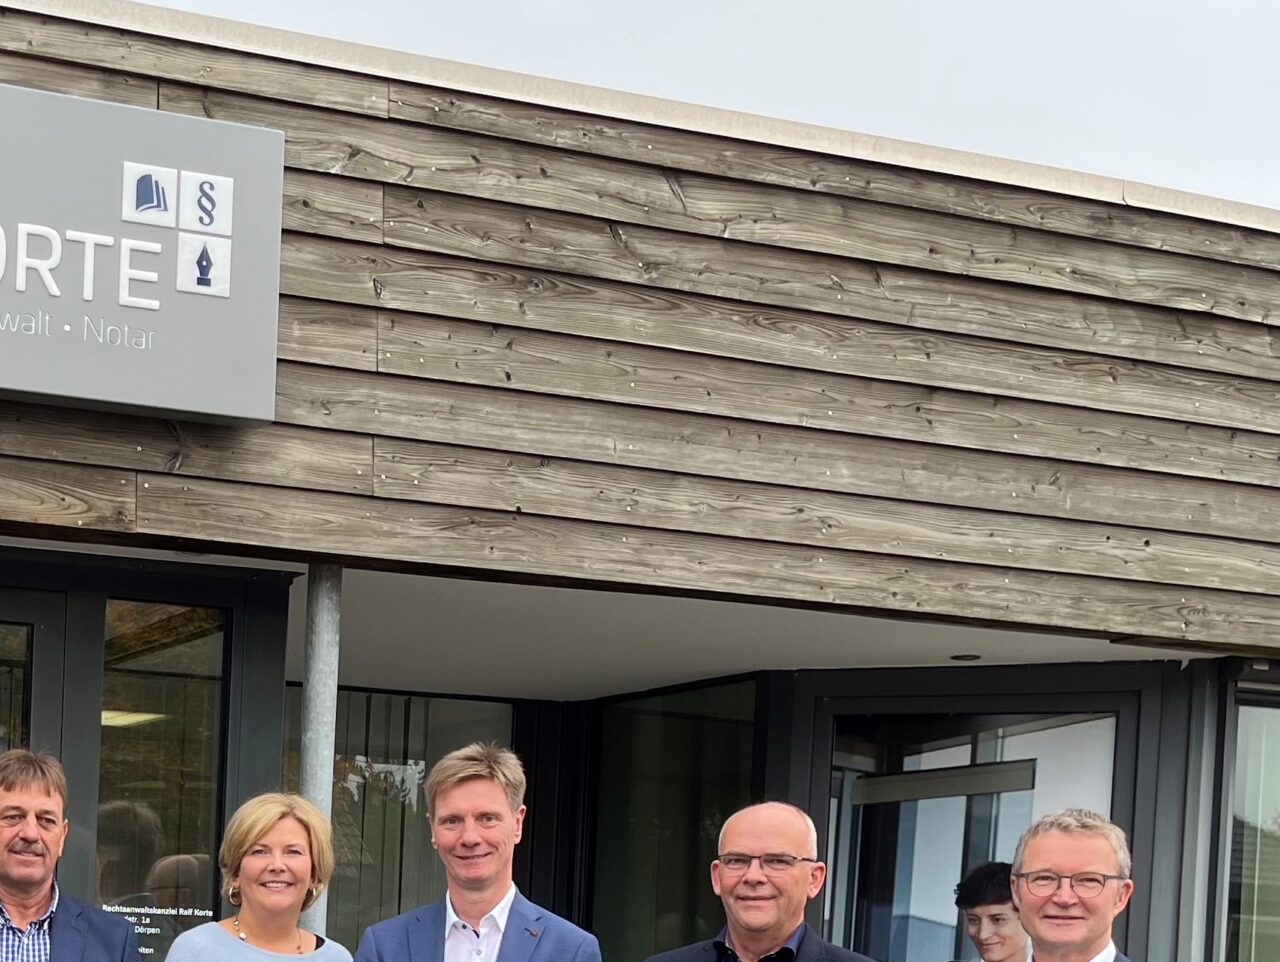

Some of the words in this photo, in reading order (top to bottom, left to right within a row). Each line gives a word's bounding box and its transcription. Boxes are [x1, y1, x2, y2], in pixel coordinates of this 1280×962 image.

[83, 315, 157, 350] Notar
[102, 904, 178, 916] Rechtsanwaltskanzlei
[178, 908, 194, 916] Ralf
[194, 909, 213, 917] Korte
